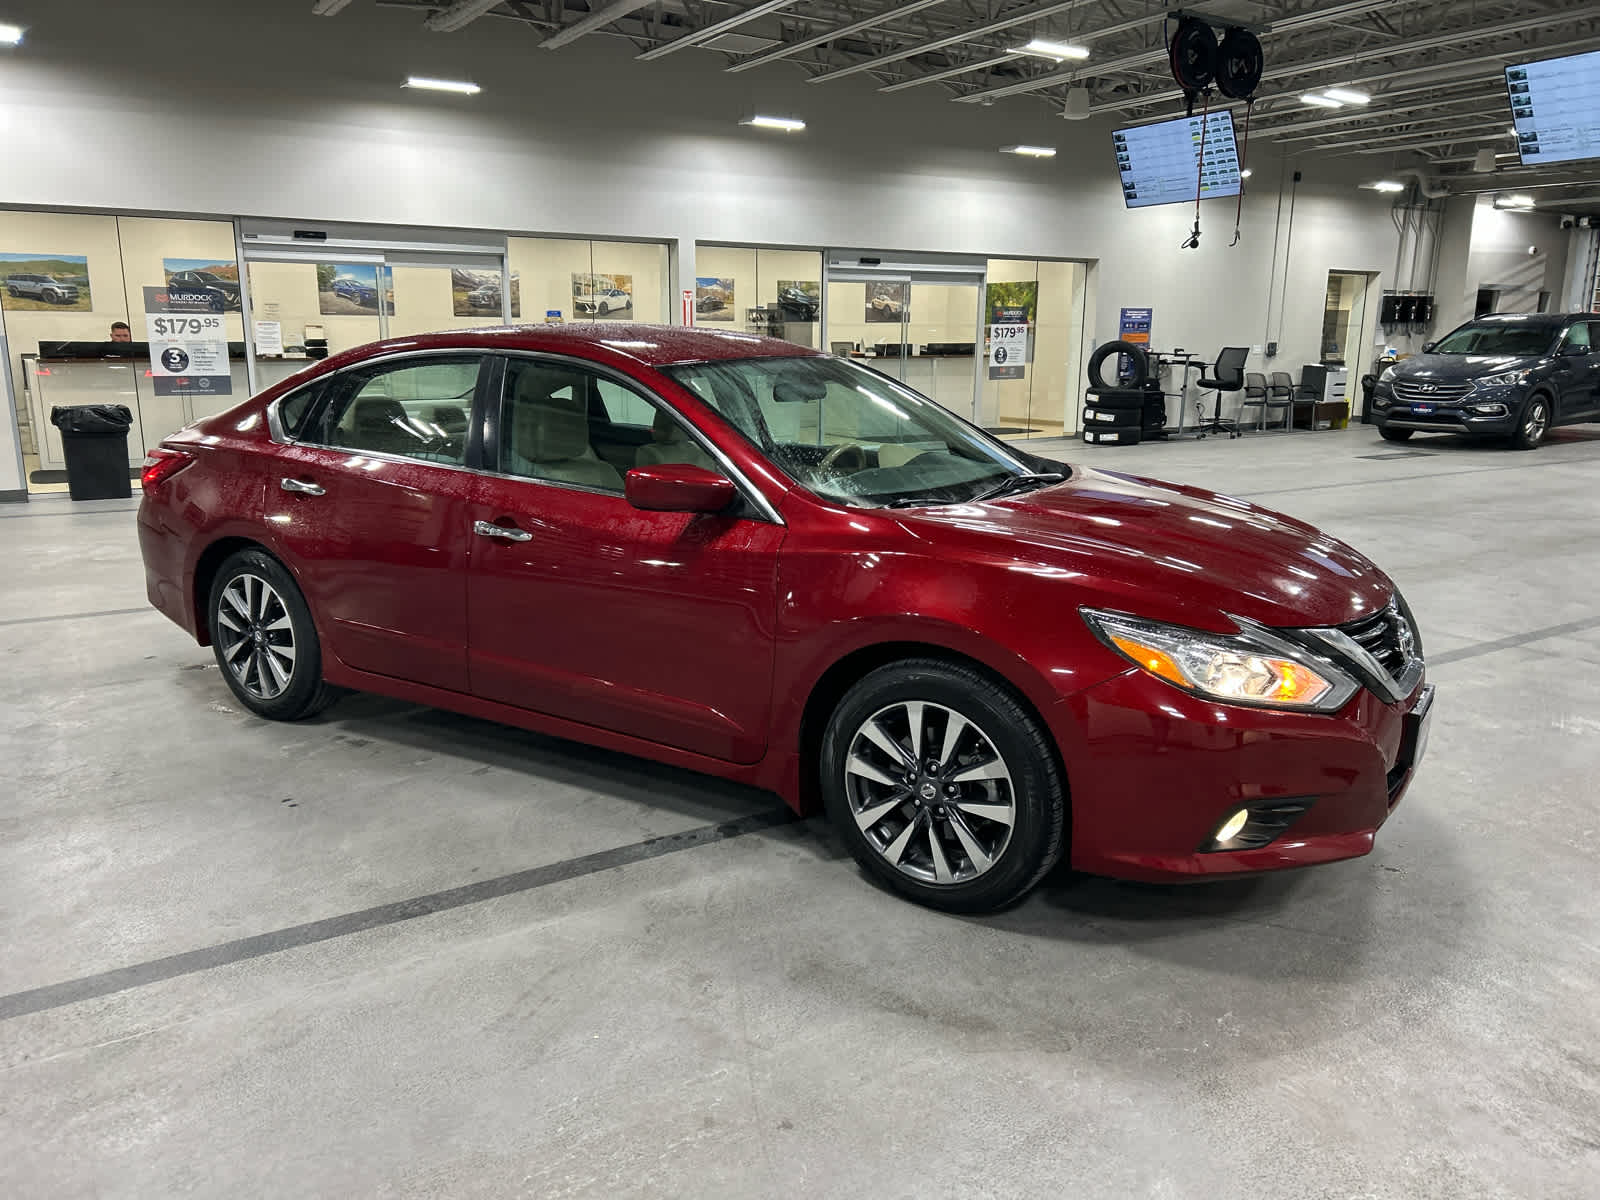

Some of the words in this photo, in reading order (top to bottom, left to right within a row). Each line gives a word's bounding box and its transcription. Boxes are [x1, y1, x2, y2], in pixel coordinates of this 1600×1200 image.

[169, 293, 213, 301] MURDOCK
[154, 317, 220, 336] $179.95
[169, 349, 181, 363] 3
